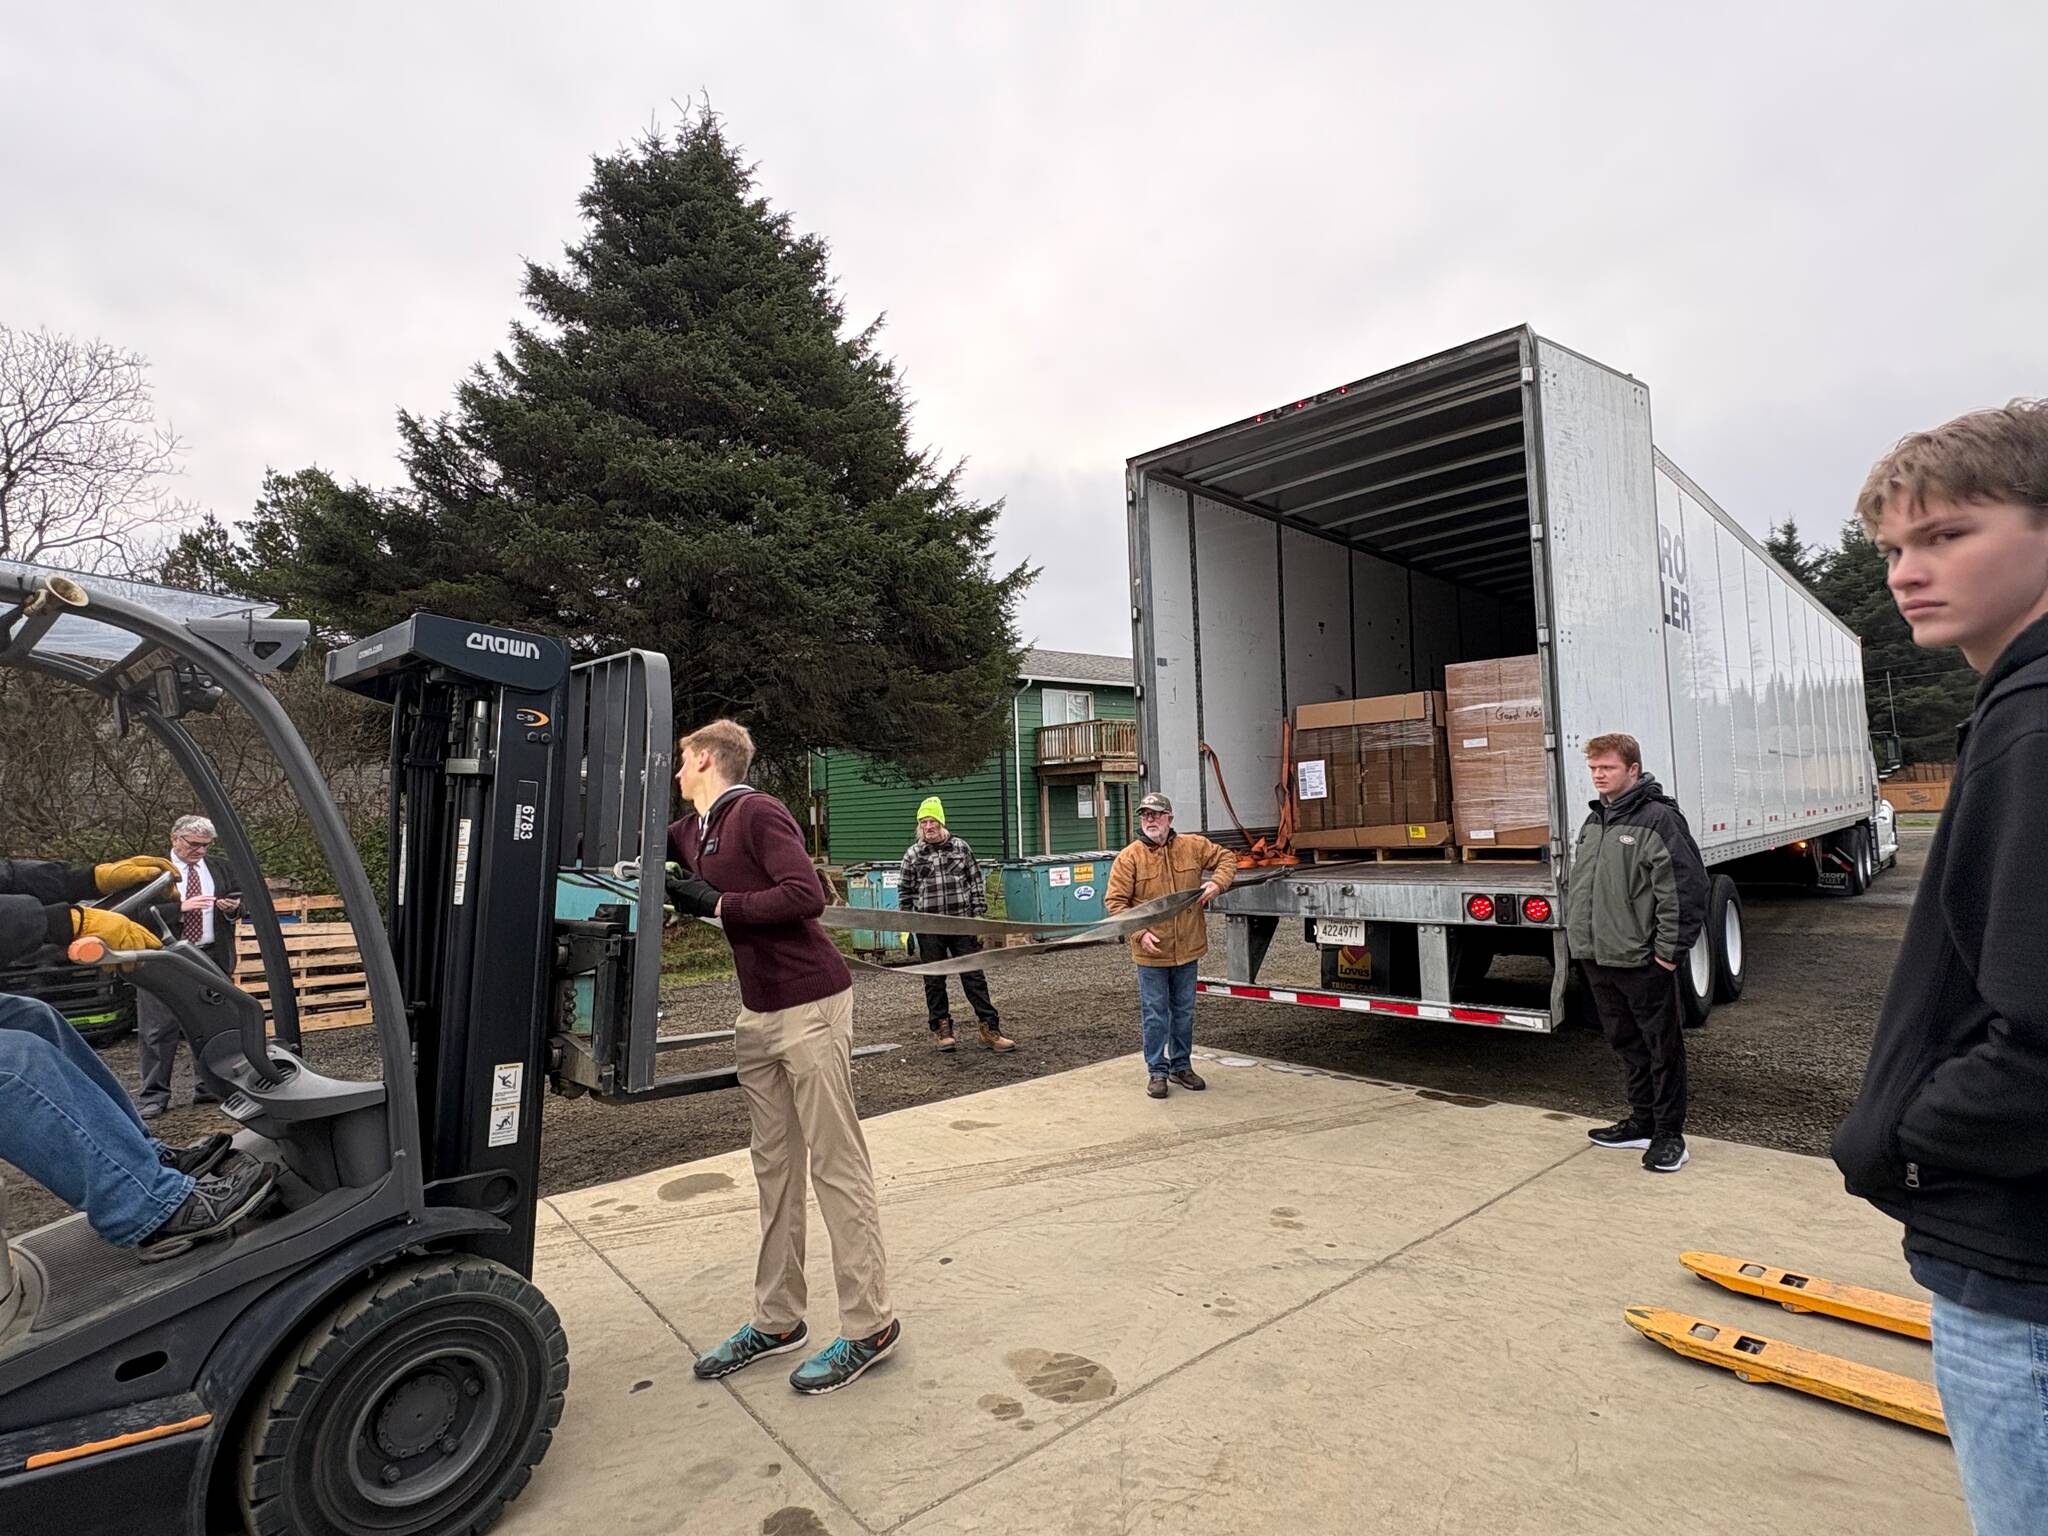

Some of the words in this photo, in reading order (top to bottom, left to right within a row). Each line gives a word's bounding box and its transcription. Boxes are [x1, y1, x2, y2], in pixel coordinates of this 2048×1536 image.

[466, 632, 540, 660] CROWN
[520, 805, 535, 840] 6783
[1322, 924, 1359, 938] 422497T
